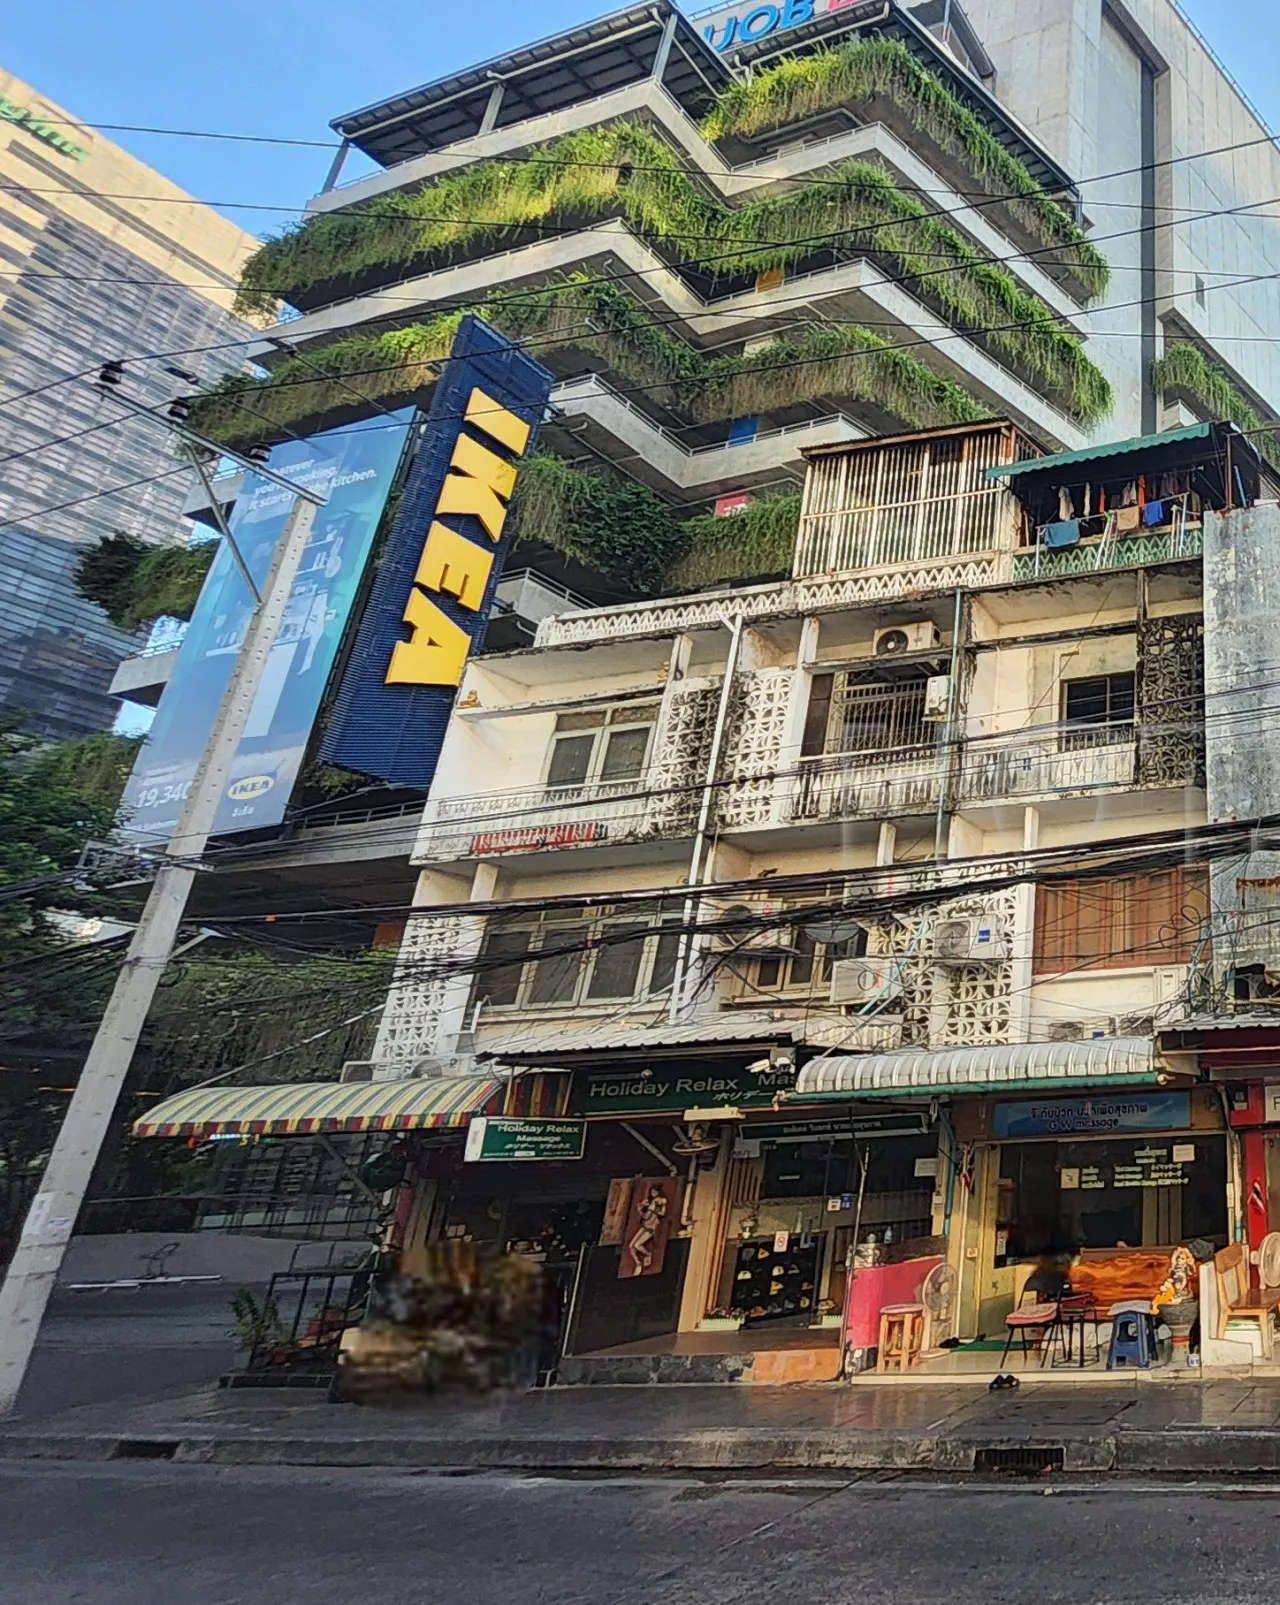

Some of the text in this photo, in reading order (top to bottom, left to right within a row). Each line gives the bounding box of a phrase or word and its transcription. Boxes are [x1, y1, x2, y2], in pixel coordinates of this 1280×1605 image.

[704, 0, 815, 51] UOB
[385, 387, 531, 687] IKEA
[232, 779, 271, 796] IKEA
[589, 1080, 669, 1097] Holiday
[675, 1077, 740, 1093] Relax
[497, 1123, 580, 1134] Holiday Relax
[515, 1134, 562, 1143] Massage
